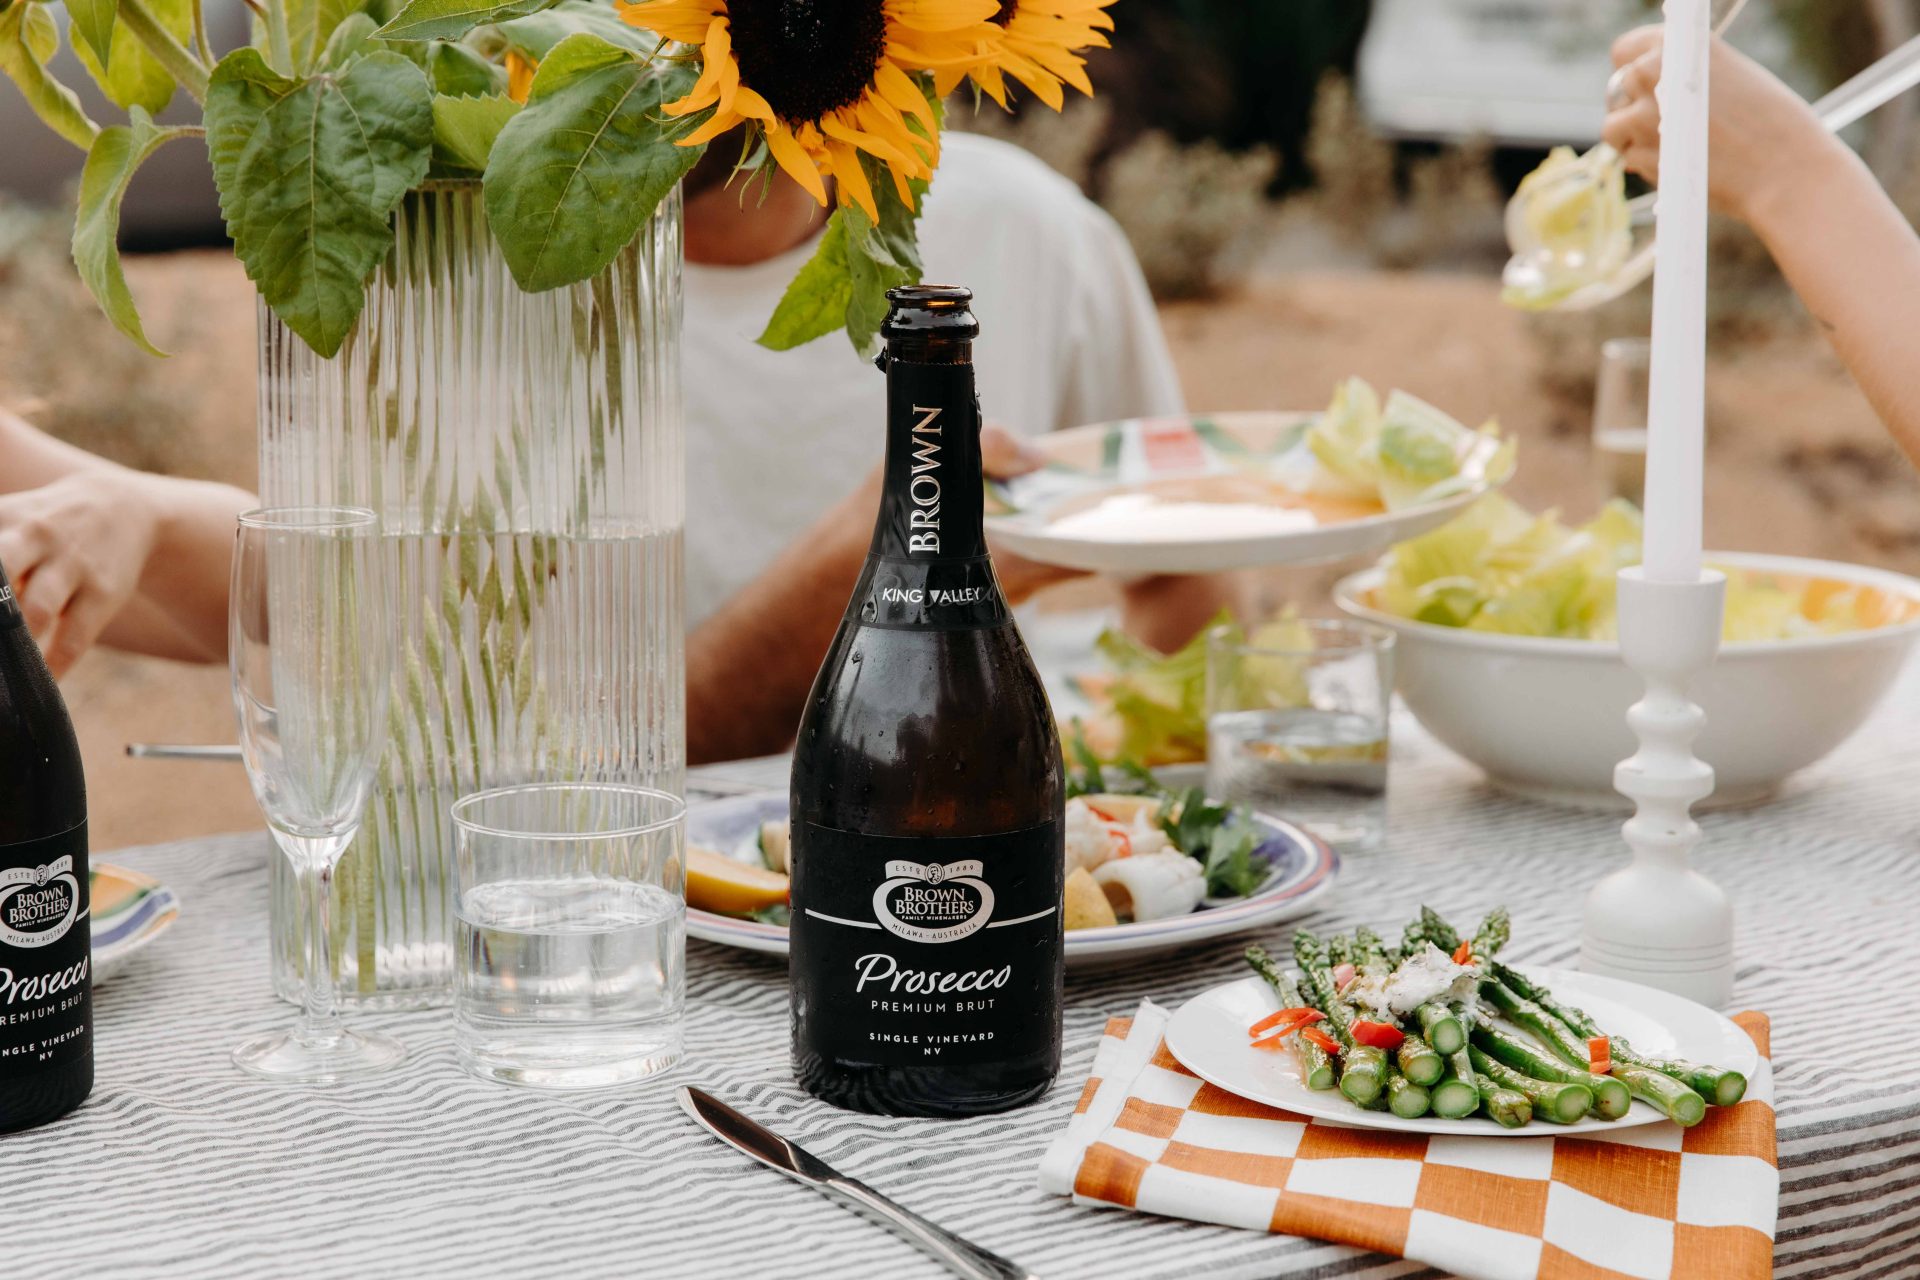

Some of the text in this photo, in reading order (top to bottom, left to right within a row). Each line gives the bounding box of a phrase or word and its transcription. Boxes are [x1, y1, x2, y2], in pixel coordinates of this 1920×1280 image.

[909, 404, 943, 555] BROWN
[882, 587, 923, 603] KING
[929, 587, 981, 603] VALLEY
[17, 885, 64, 909] BROWN
[903, 886, 966, 902] BROWN
[9, 896, 70, 924] BROTHERS
[895, 899, 975, 915] BROTHERS
[15, 920, 35, 929] FAMILY
[892, 923, 923, 938] MILAWA
[931, 923, 977, 939] AUSTRALIA
[854, 953, 1012, 995] Prosecco
[61, 992, 83, 1011] BRUT
[871, 999, 995, 1013] PREMIUM BRUT
[41, 1025, 84, 1048] VINEYARD
[869, 1032, 995, 1044] SINGLE VINEYARD
[39, 1051, 53, 1062] NV
[924, 1047, 941, 1056] NV
